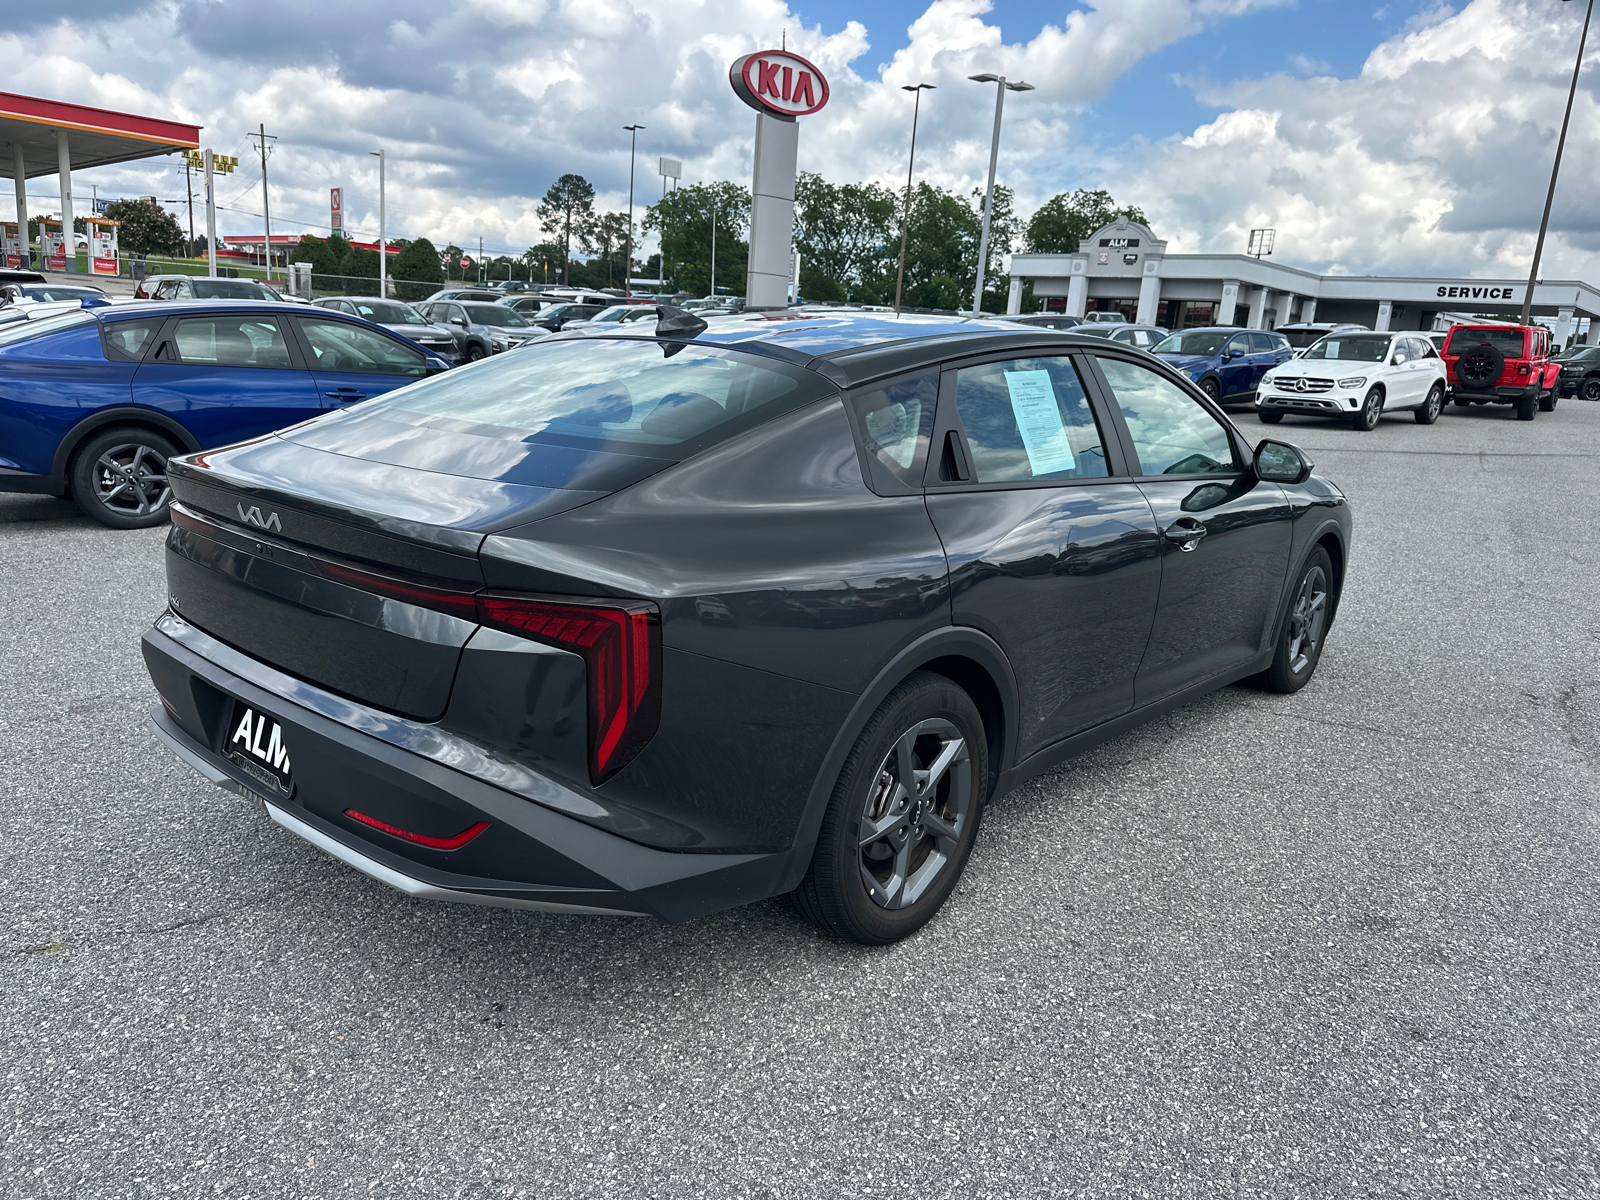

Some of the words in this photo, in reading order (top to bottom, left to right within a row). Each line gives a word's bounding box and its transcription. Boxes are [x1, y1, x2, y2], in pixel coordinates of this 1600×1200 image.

[758, 59, 815, 107] KIA
[182, 150, 238, 166] WAFLE
[187, 159, 234, 173] HOSE
[1108, 239, 1128, 247] ALM
[1436, 286, 1514, 299] SERVICE
[232, 708, 290, 775] ALM
